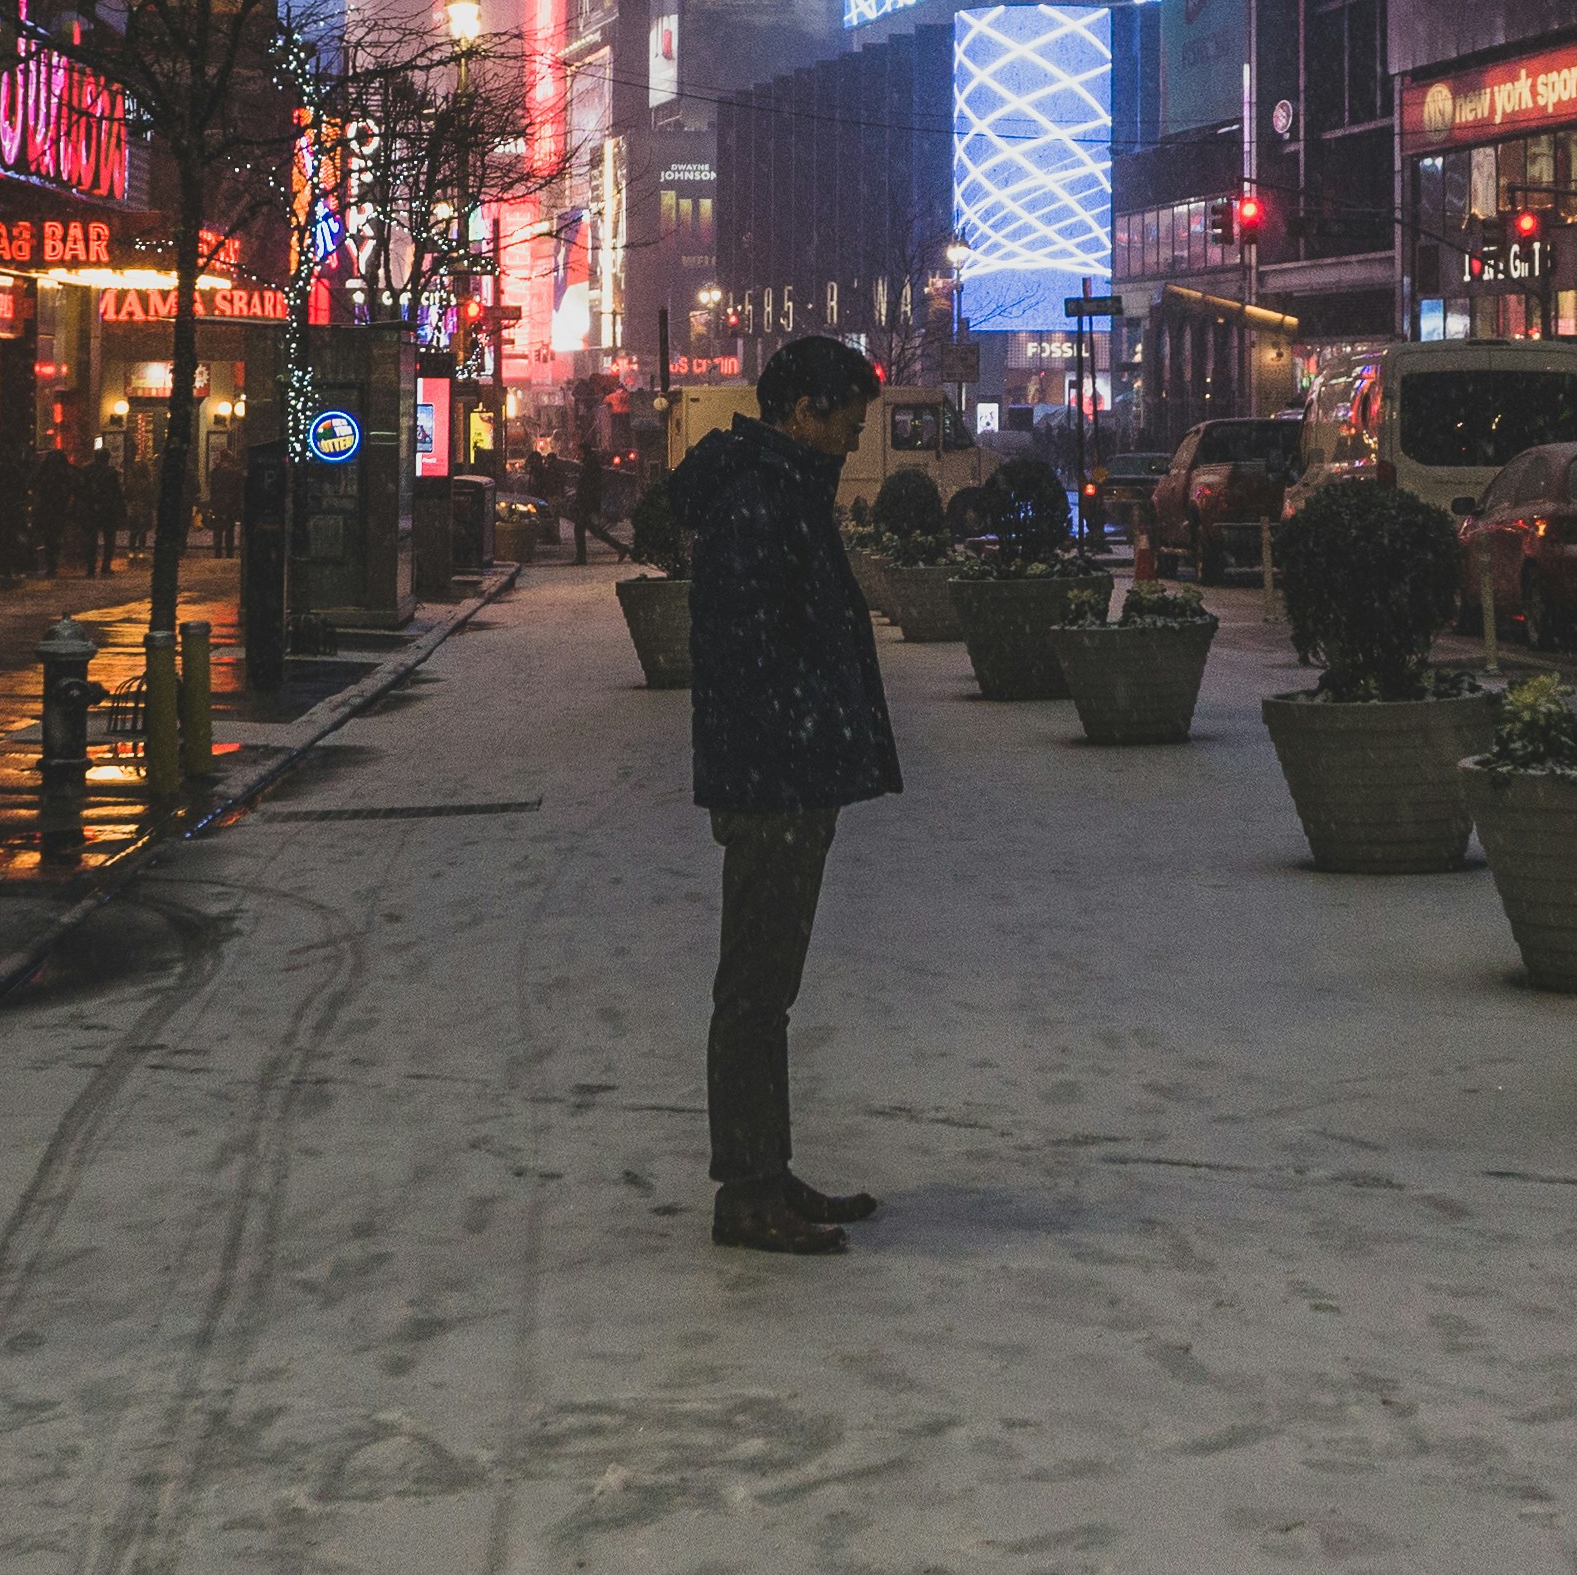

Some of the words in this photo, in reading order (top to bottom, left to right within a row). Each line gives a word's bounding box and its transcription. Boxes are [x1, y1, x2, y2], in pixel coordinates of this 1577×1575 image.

[1454, 88, 1491, 124] new
[1494, 68, 1534, 124] york
[671, 163, 710, 171] DWAYNE
[43, 221, 111, 263] BAR
[213, 289, 289, 320] SBARR
[1026, 342, 1090, 358] FOSSIL
